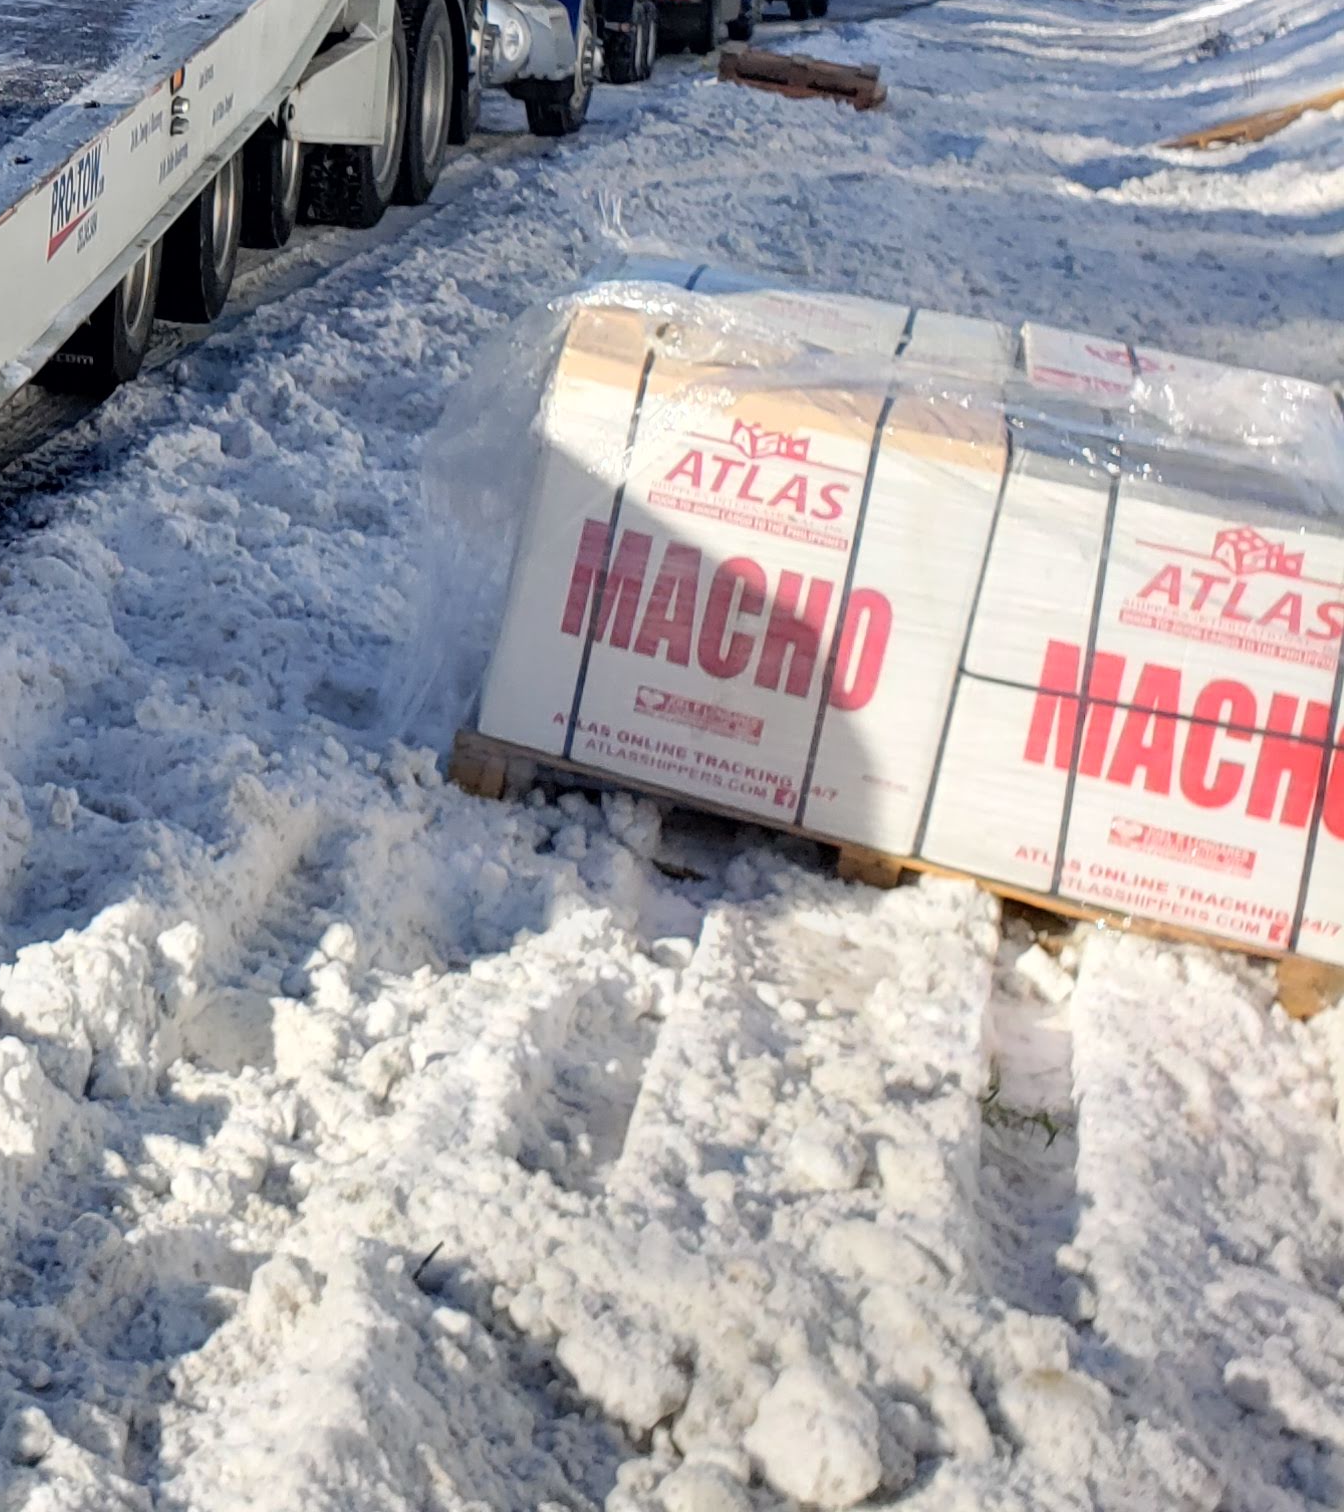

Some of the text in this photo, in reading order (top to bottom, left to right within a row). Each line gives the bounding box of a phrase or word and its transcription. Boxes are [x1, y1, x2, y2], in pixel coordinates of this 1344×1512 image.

[665, 449, 850, 520] ATLAS
[561, 518, 893, 711] MACHO
[1137, 563, 1344, 642] ATLAS
[552, 711, 611, 739] ALAS
[617, 729, 688, 760] ONLINE
[695, 750, 794, 787] TRACKING
[1023, 638, 1344, 841] MACH
[1089, 862, 1170, 892] ONLINE
[1177, 884, 1290, 922] TRACKING
